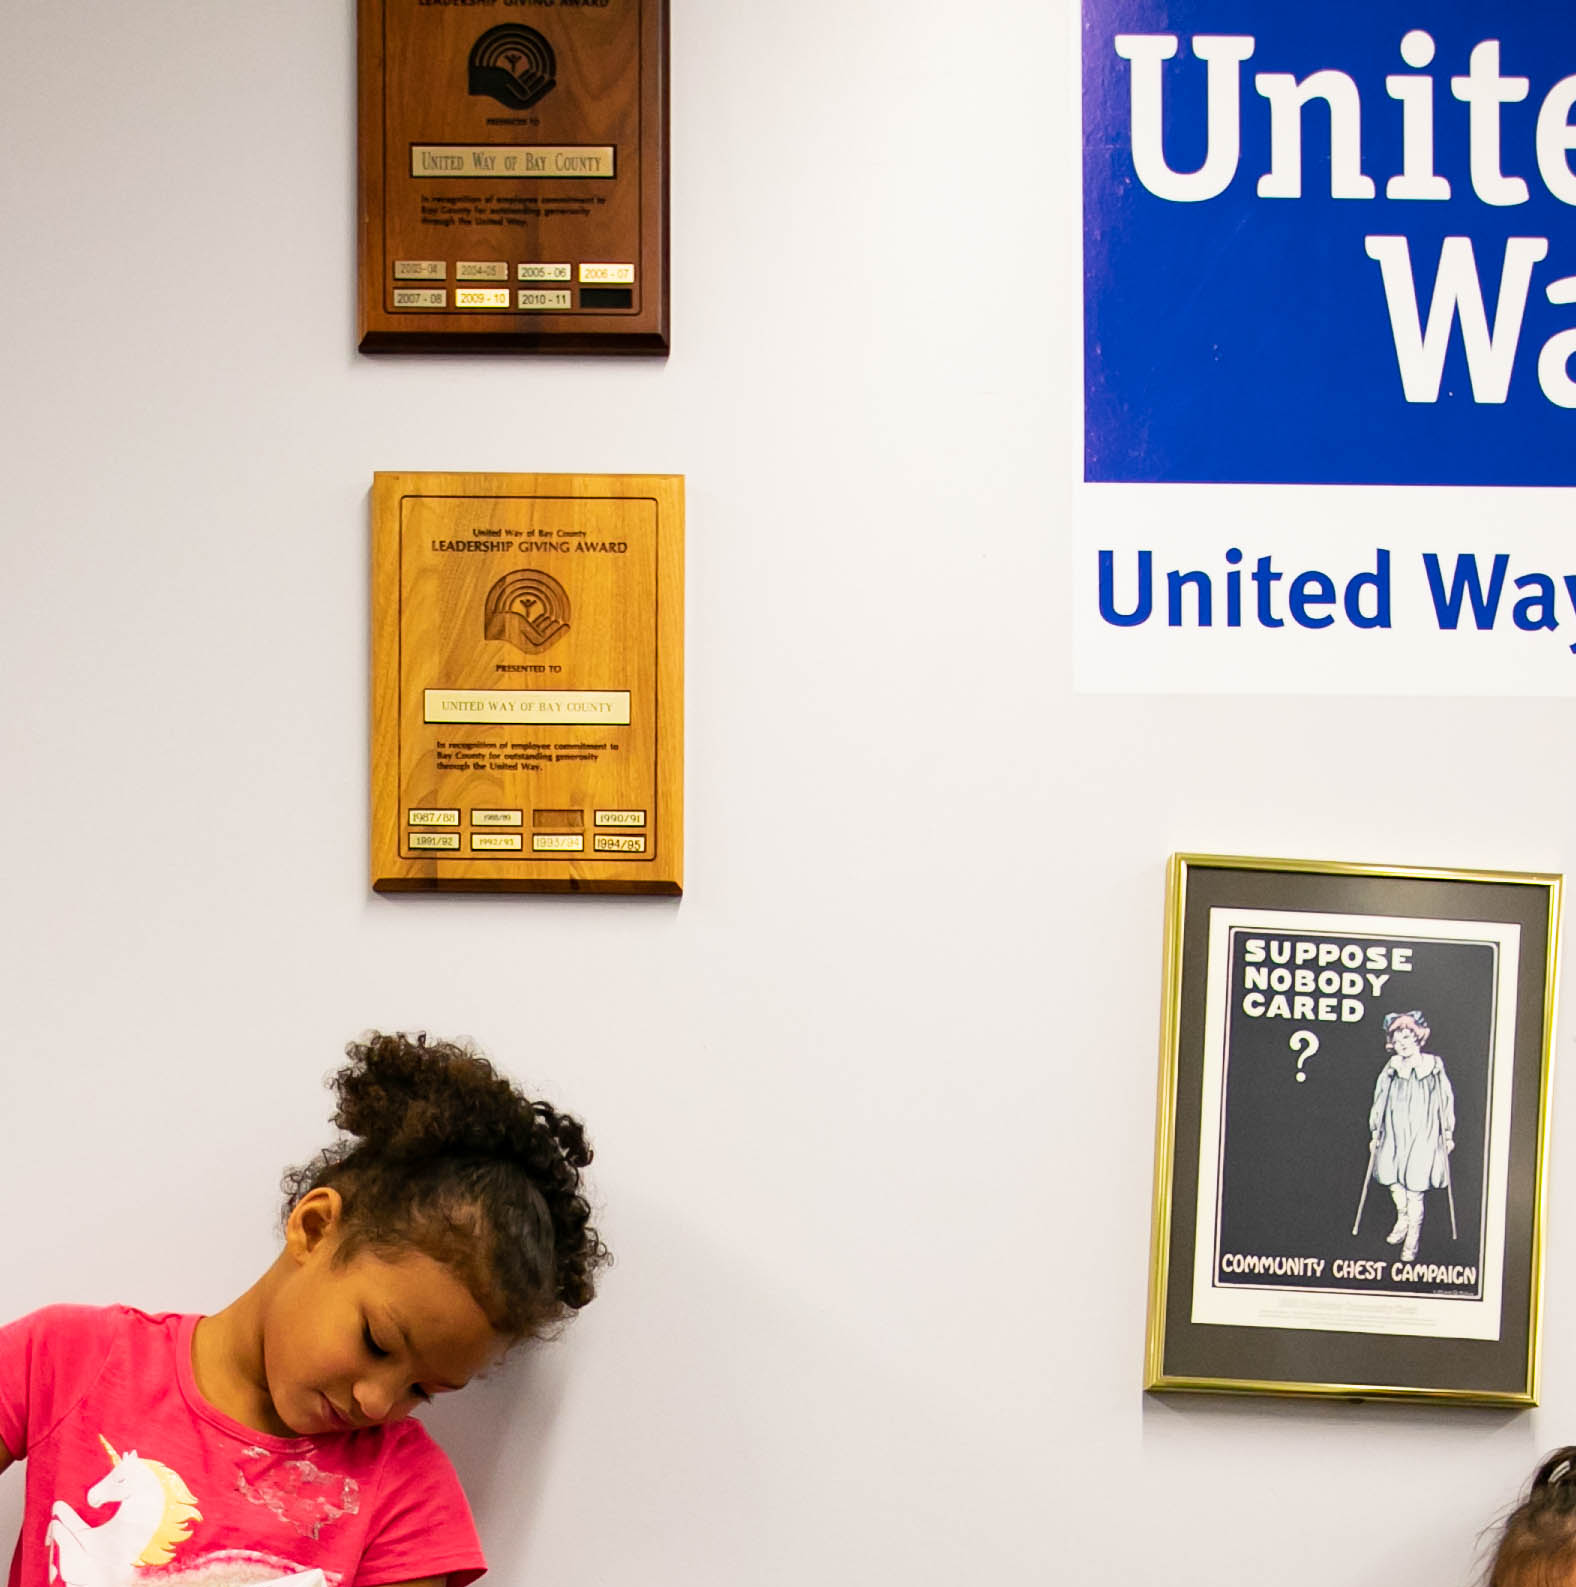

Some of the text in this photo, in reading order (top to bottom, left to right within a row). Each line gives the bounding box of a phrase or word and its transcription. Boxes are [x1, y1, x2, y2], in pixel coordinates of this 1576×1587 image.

[521, 267, 566, 278] 2005 06
[584, 268, 629, 279] 2006 07
[397, 293, 443, 304] 2007 08
[461, 293, 505, 304] 2009 10
[522, 294, 566, 305] 2010 11
[473, 529, 586, 538] United Way of Bay County
[432, 540, 628, 553] LEADERSHIP GIVING AWARD
[1096, 548, 1392, 630] United
[496, 665, 561, 673] PRESENTED TO
[442, 701, 613, 712] UNITED WAY OF BAY COUNTY
[449, 742, 496, 751] recognition
[499, 741, 508, 750] of
[511, 742, 551, 751] employee
[437, 751, 598, 762] Bay County for outstanding generosity
[437, 762, 542, 772] through the United Way.
[600, 814, 641, 823] 1990/91
[597, 838, 641, 850] 1994/95
[1244, 939, 1413, 973] SUPPOSE
[1244, 967, 1390, 998] NOBODY
[1242, 992, 1365, 1023] CARED
[1288, 1029, 1320, 1083] ?
[1221, 1253, 1477, 1285] COMMUNITY CHEST CAMPAIGN
